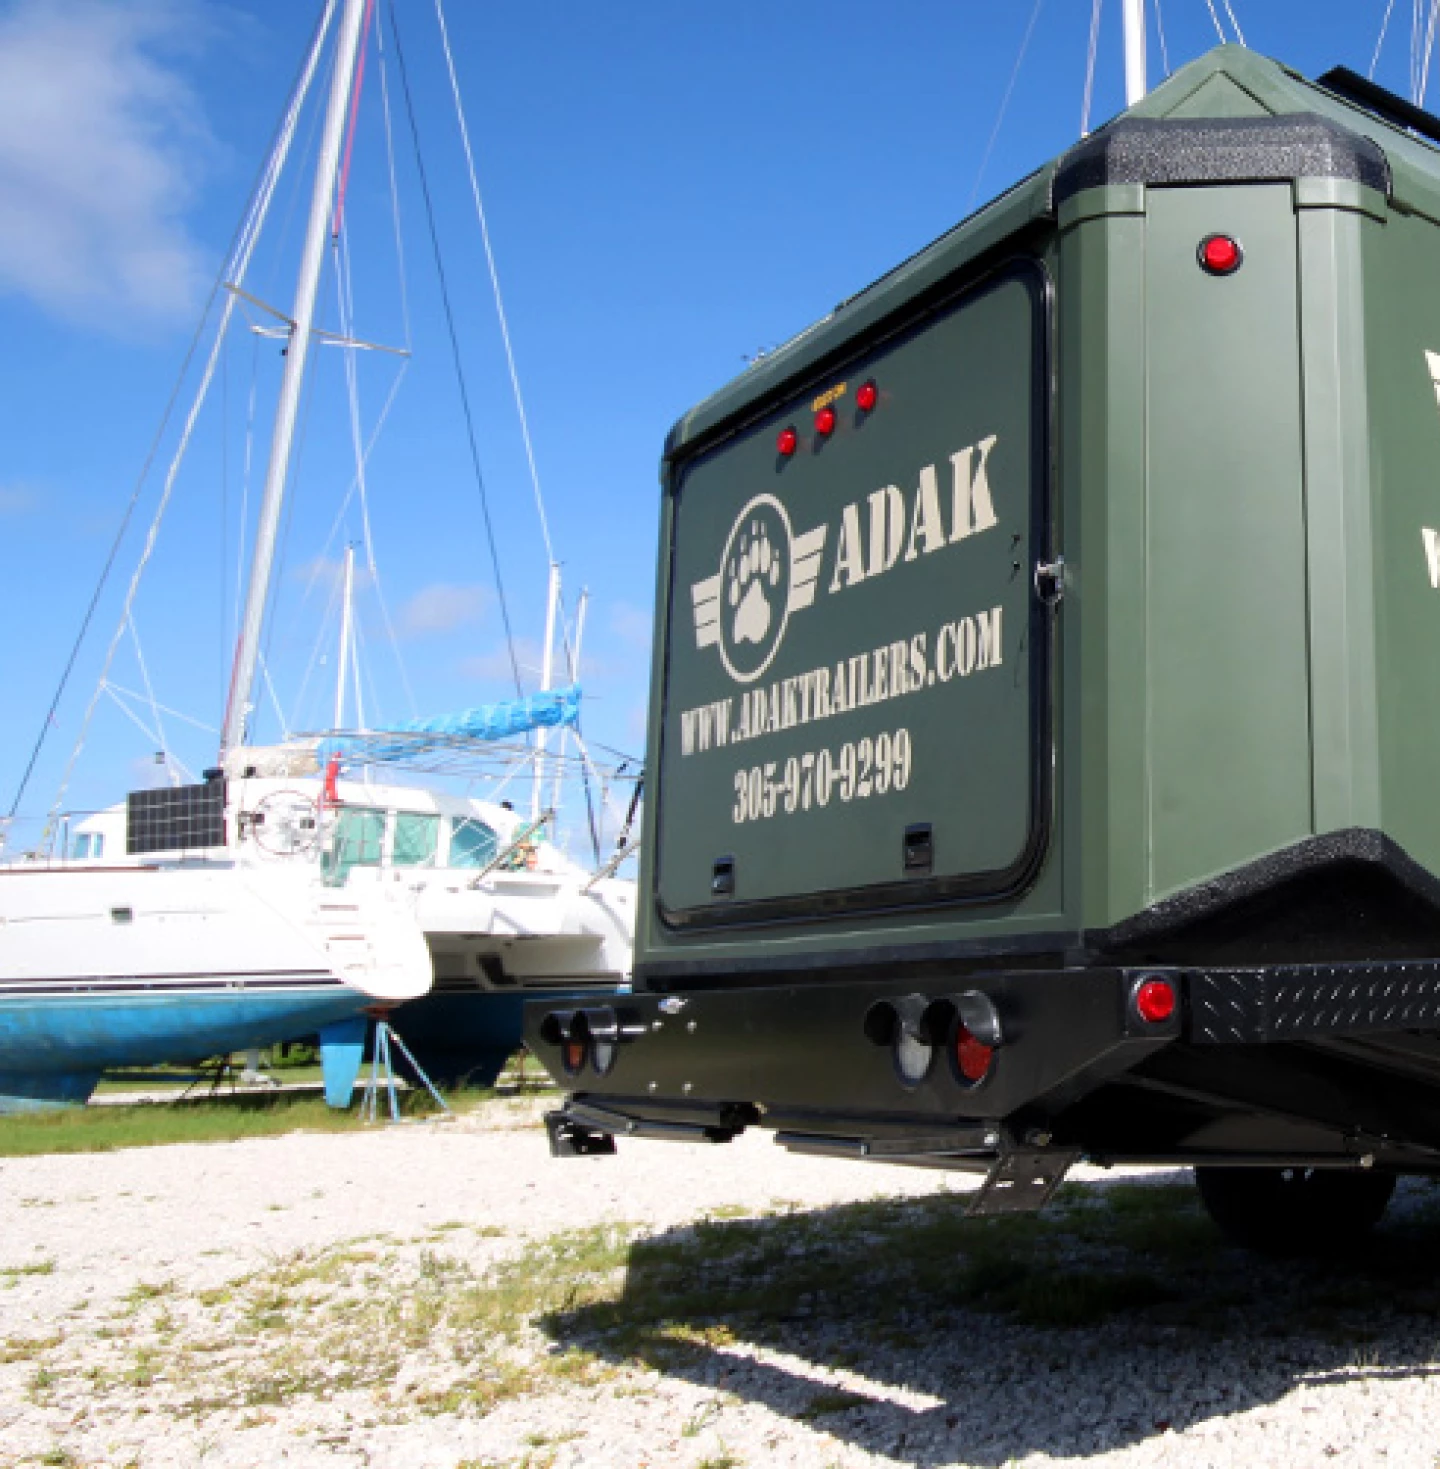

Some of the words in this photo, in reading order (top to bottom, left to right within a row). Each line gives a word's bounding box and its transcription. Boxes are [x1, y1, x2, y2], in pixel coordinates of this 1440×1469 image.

[827, 434, 999, 594] ADAK
[681, 605, 1003, 756] WWW.ADAKTRAILERS.COM
[732, 728, 912, 824] 305-970-9299
